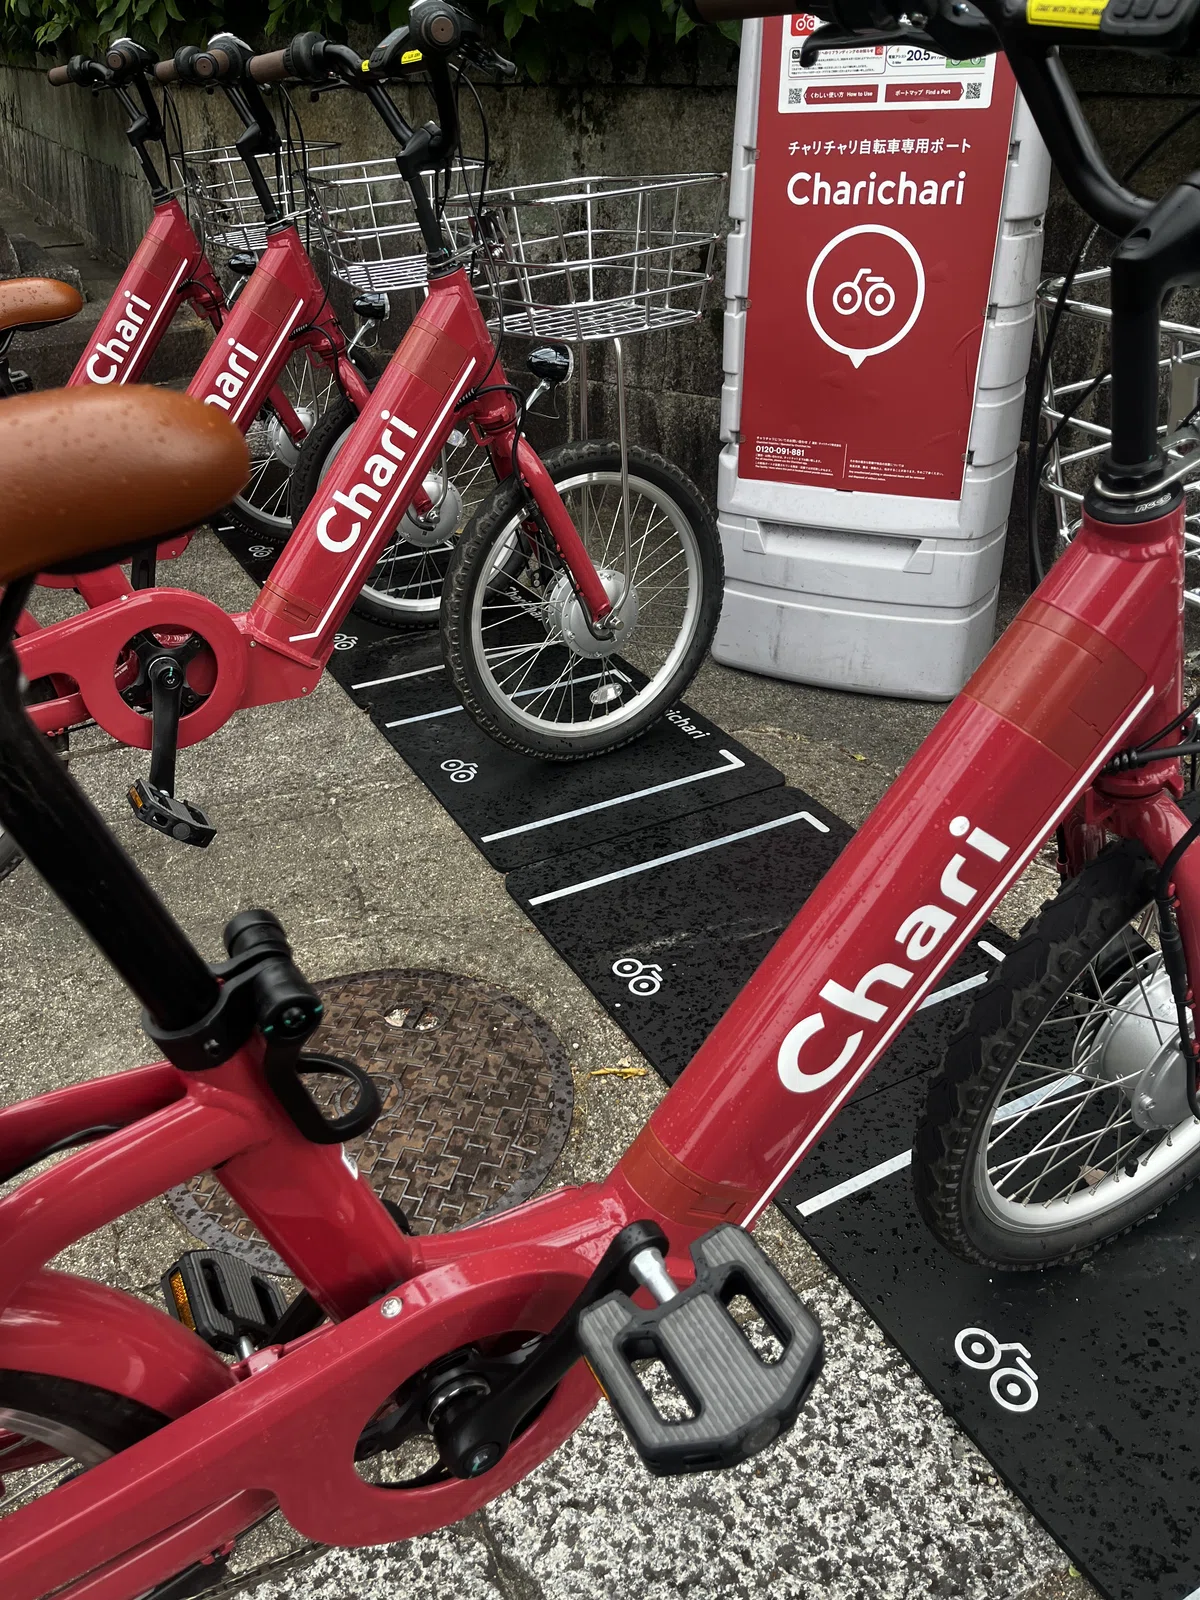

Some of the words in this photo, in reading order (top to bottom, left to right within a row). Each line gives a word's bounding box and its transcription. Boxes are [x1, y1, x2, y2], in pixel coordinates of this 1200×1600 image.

[906, 49, 930, 61] 20.5
[810, 91, 844, 99] くわしい使い方
[788, 137, 972, 156] チャリチャリ自転車専用ポート
[786, 170, 966, 206] Charichari
[86, 290, 152, 385] Chari
[755, 445, 805, 457] 0120-091-881
[316, 409, 418, 553] Chari
[777, 815, 1011, 1094] Chari
